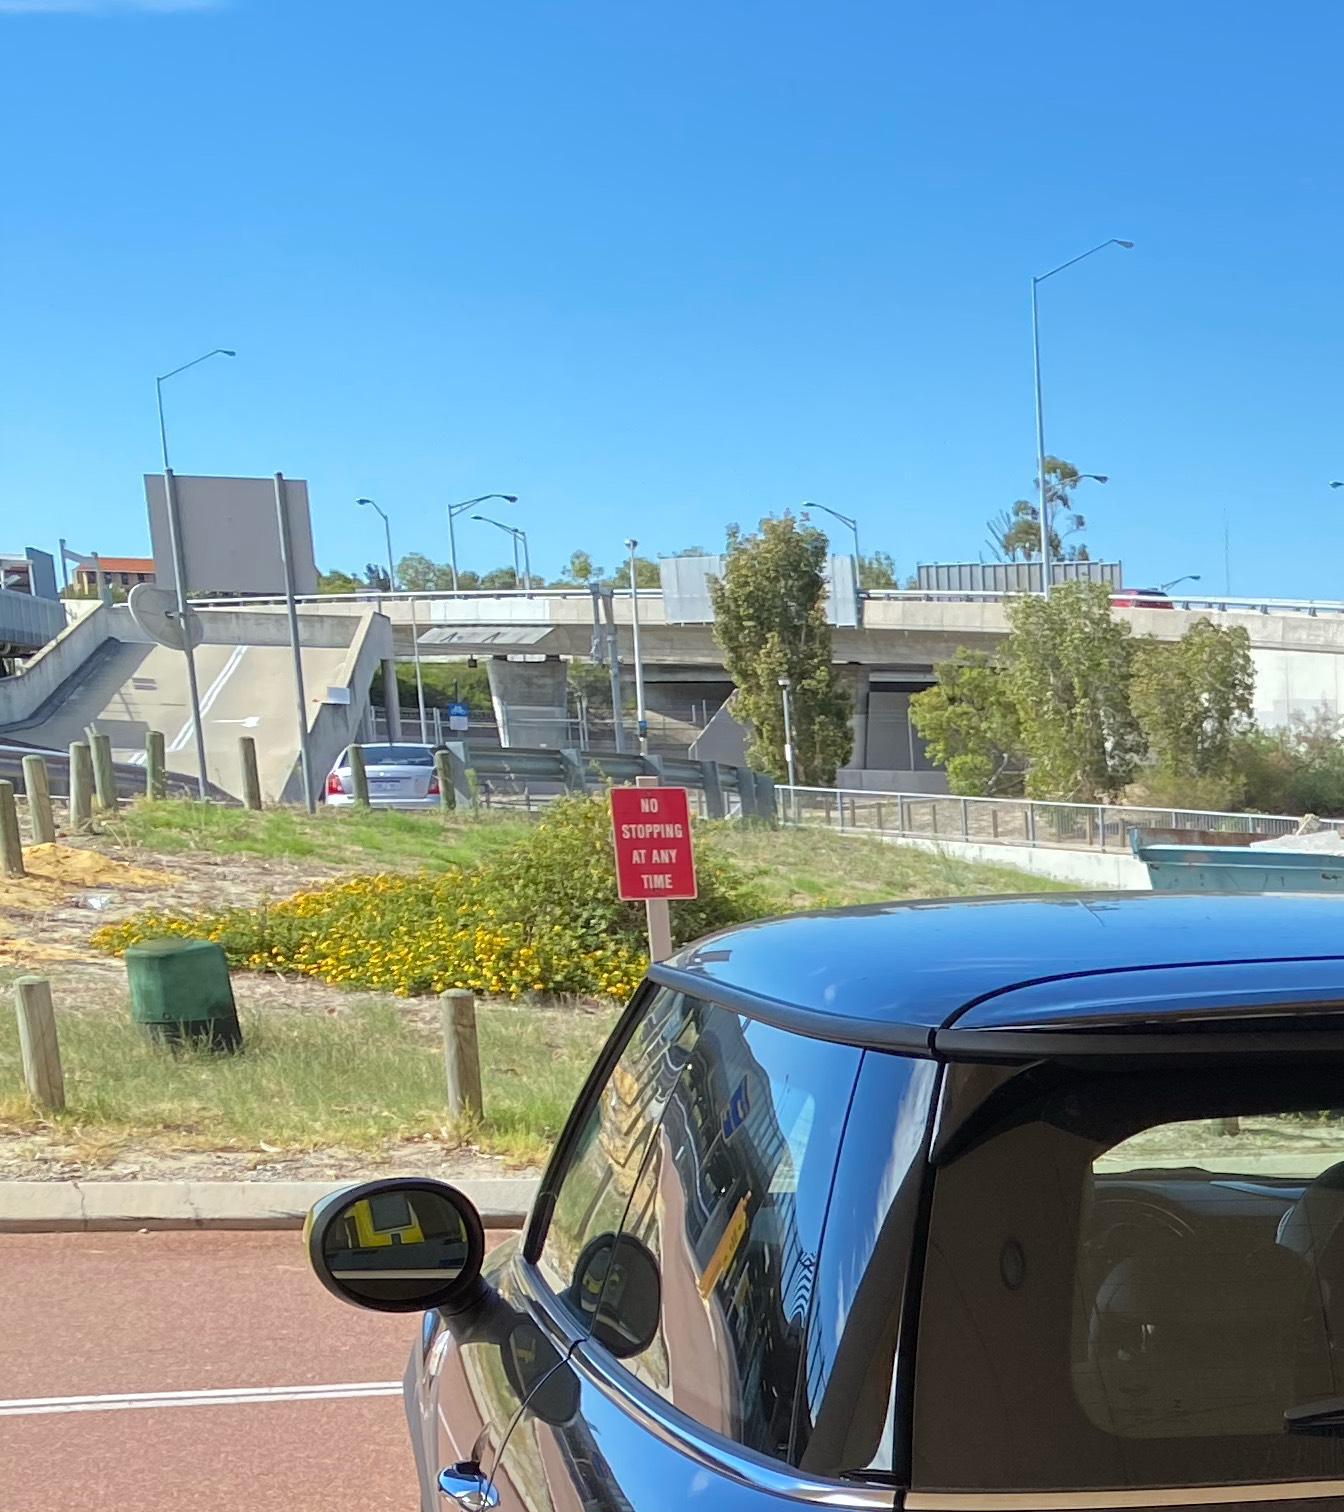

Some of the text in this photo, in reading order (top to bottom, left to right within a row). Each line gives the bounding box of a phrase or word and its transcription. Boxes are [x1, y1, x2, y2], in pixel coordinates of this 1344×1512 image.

[640, 798, 659, 813] NO
[621, 823, 683, 839] STOPPING
[631, 849, 678, 865] AT ANY
[641, 873, 673, 889] TIME
